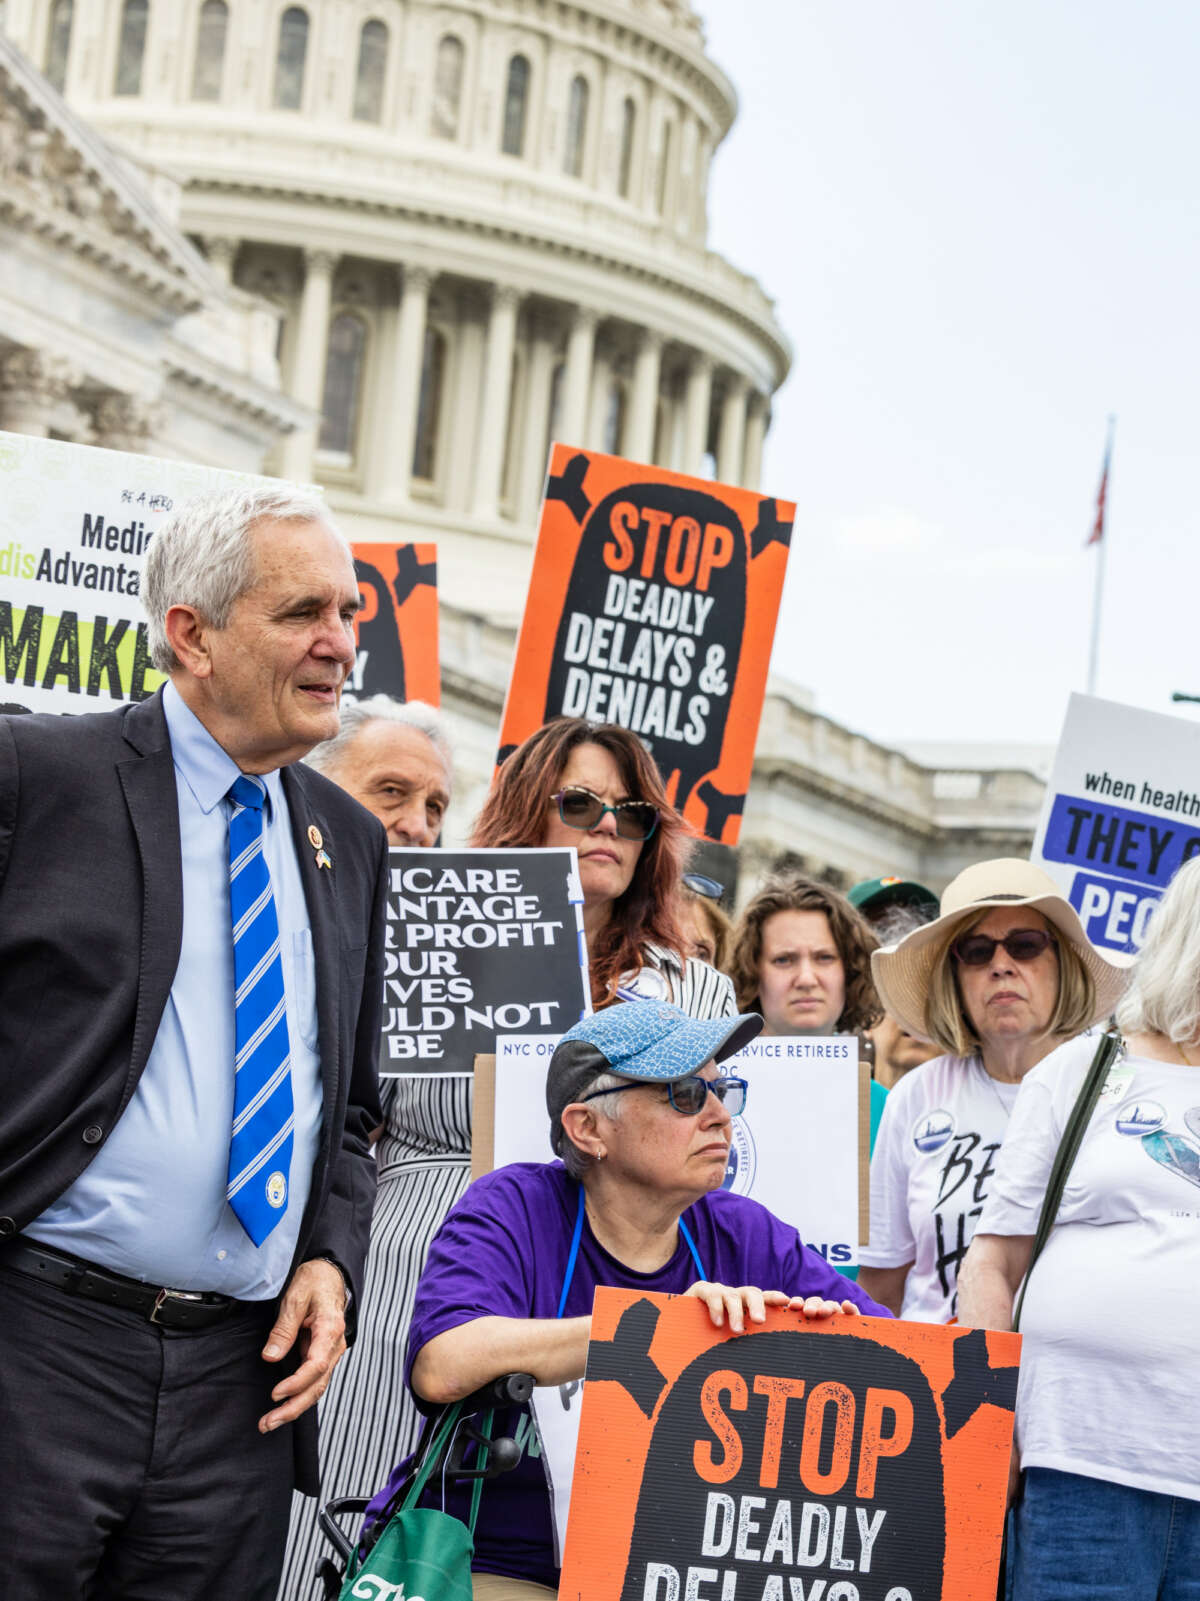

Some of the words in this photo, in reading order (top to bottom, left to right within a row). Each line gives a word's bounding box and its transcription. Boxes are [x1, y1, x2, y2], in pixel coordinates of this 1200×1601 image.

[81, 513, 153, 556] Medi
[602, 501, 734, 592] STOP
[0, 541, 141, 596] disAdvanta
[603, 574, 714, 636] DEADLY
[564, 612, 696, 688] DELAYS
[699, 644, 729, 697] &
[561, 667, 711, 745] DENIALS
[1084, 772, 1134, 802] when
[1066, 806, 1175, 875] THEY
[388, 867, 523, 894] ICARE
[406, 921, 563, 948] PROFIT
[464, 1001, 560, 1030] NOT
[387, 1034, 445, 1059] BE
[504, 1043, 530, 1056] NYC
[787, 1045, 848, 1058] RETIREES
[932, 1132, 1002, 1213] BE
[693, 1369, 914, 1499] STOP
[701, 1492, 887, 1573] DEADLY
